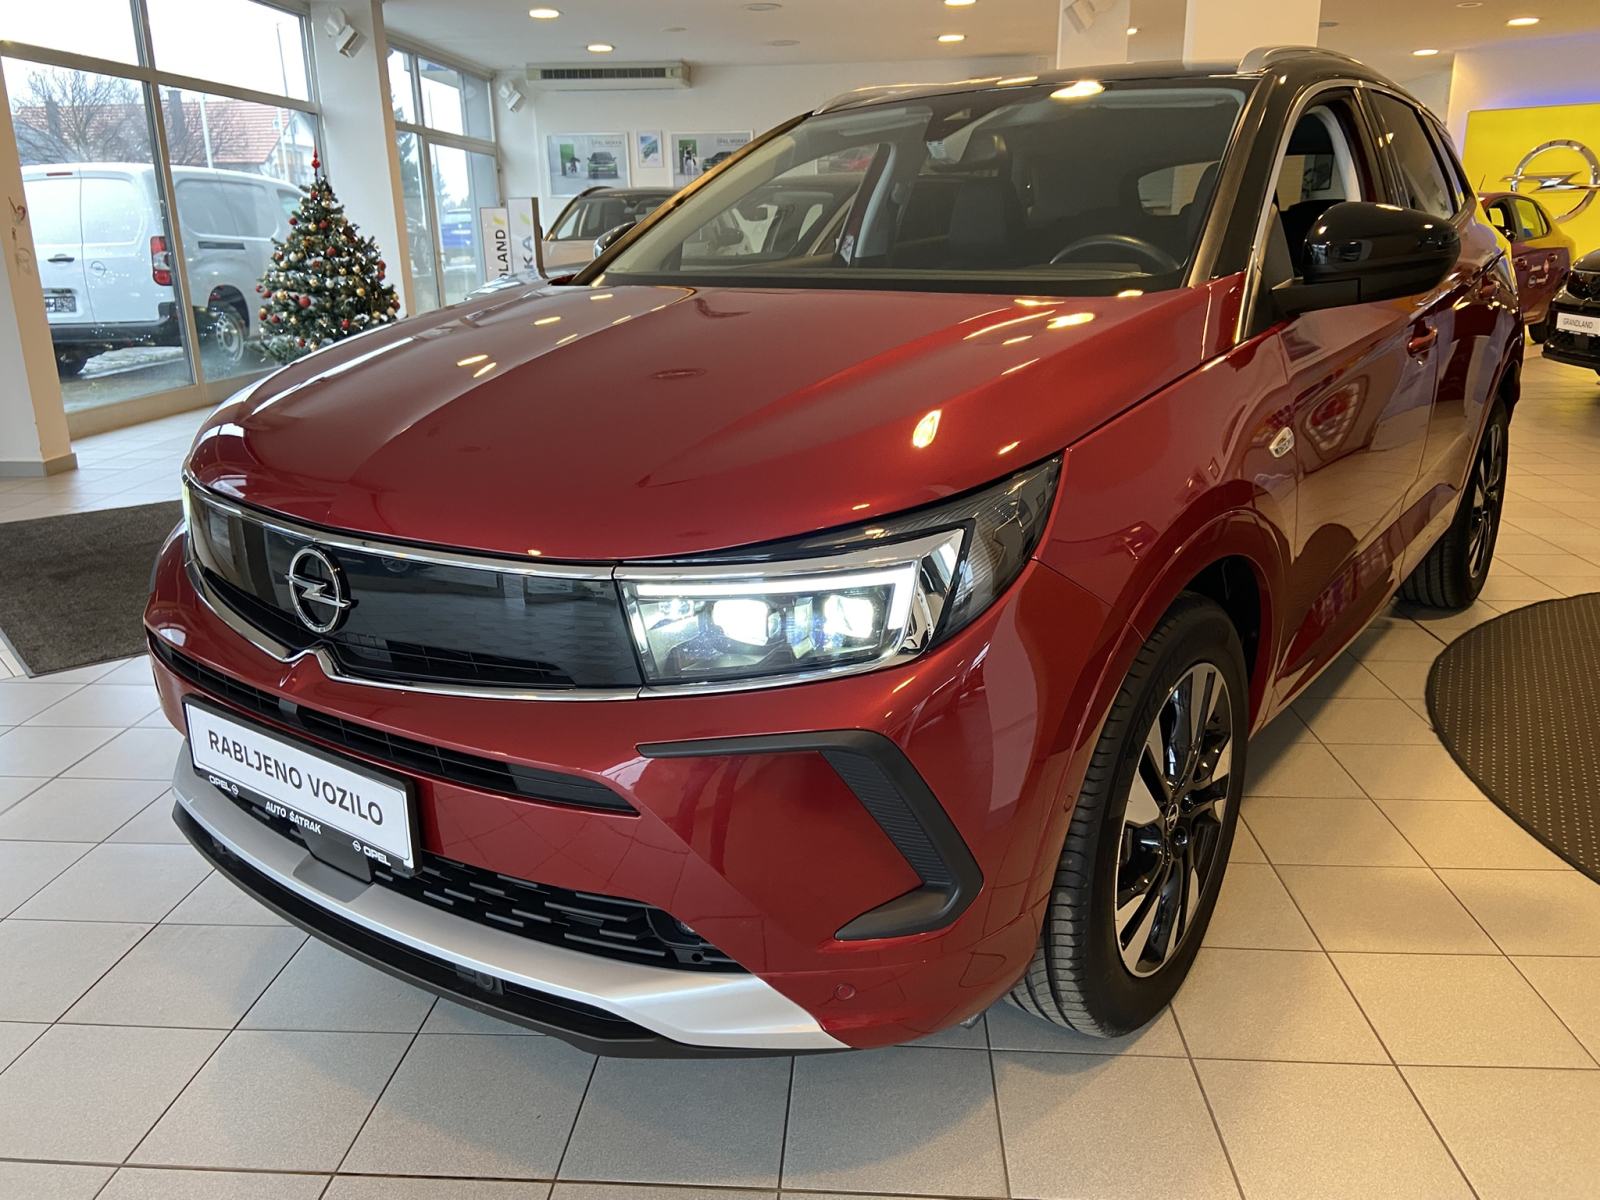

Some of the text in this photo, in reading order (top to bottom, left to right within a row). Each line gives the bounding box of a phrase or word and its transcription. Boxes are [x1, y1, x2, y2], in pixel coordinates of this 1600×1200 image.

[208, 729, 384, 826] RABLJENO VOZILO
[208, 774, 231, 792] OPEL
[265, 801, 287, 818] AUTO
[363, 845, 392, 867] OPEL
